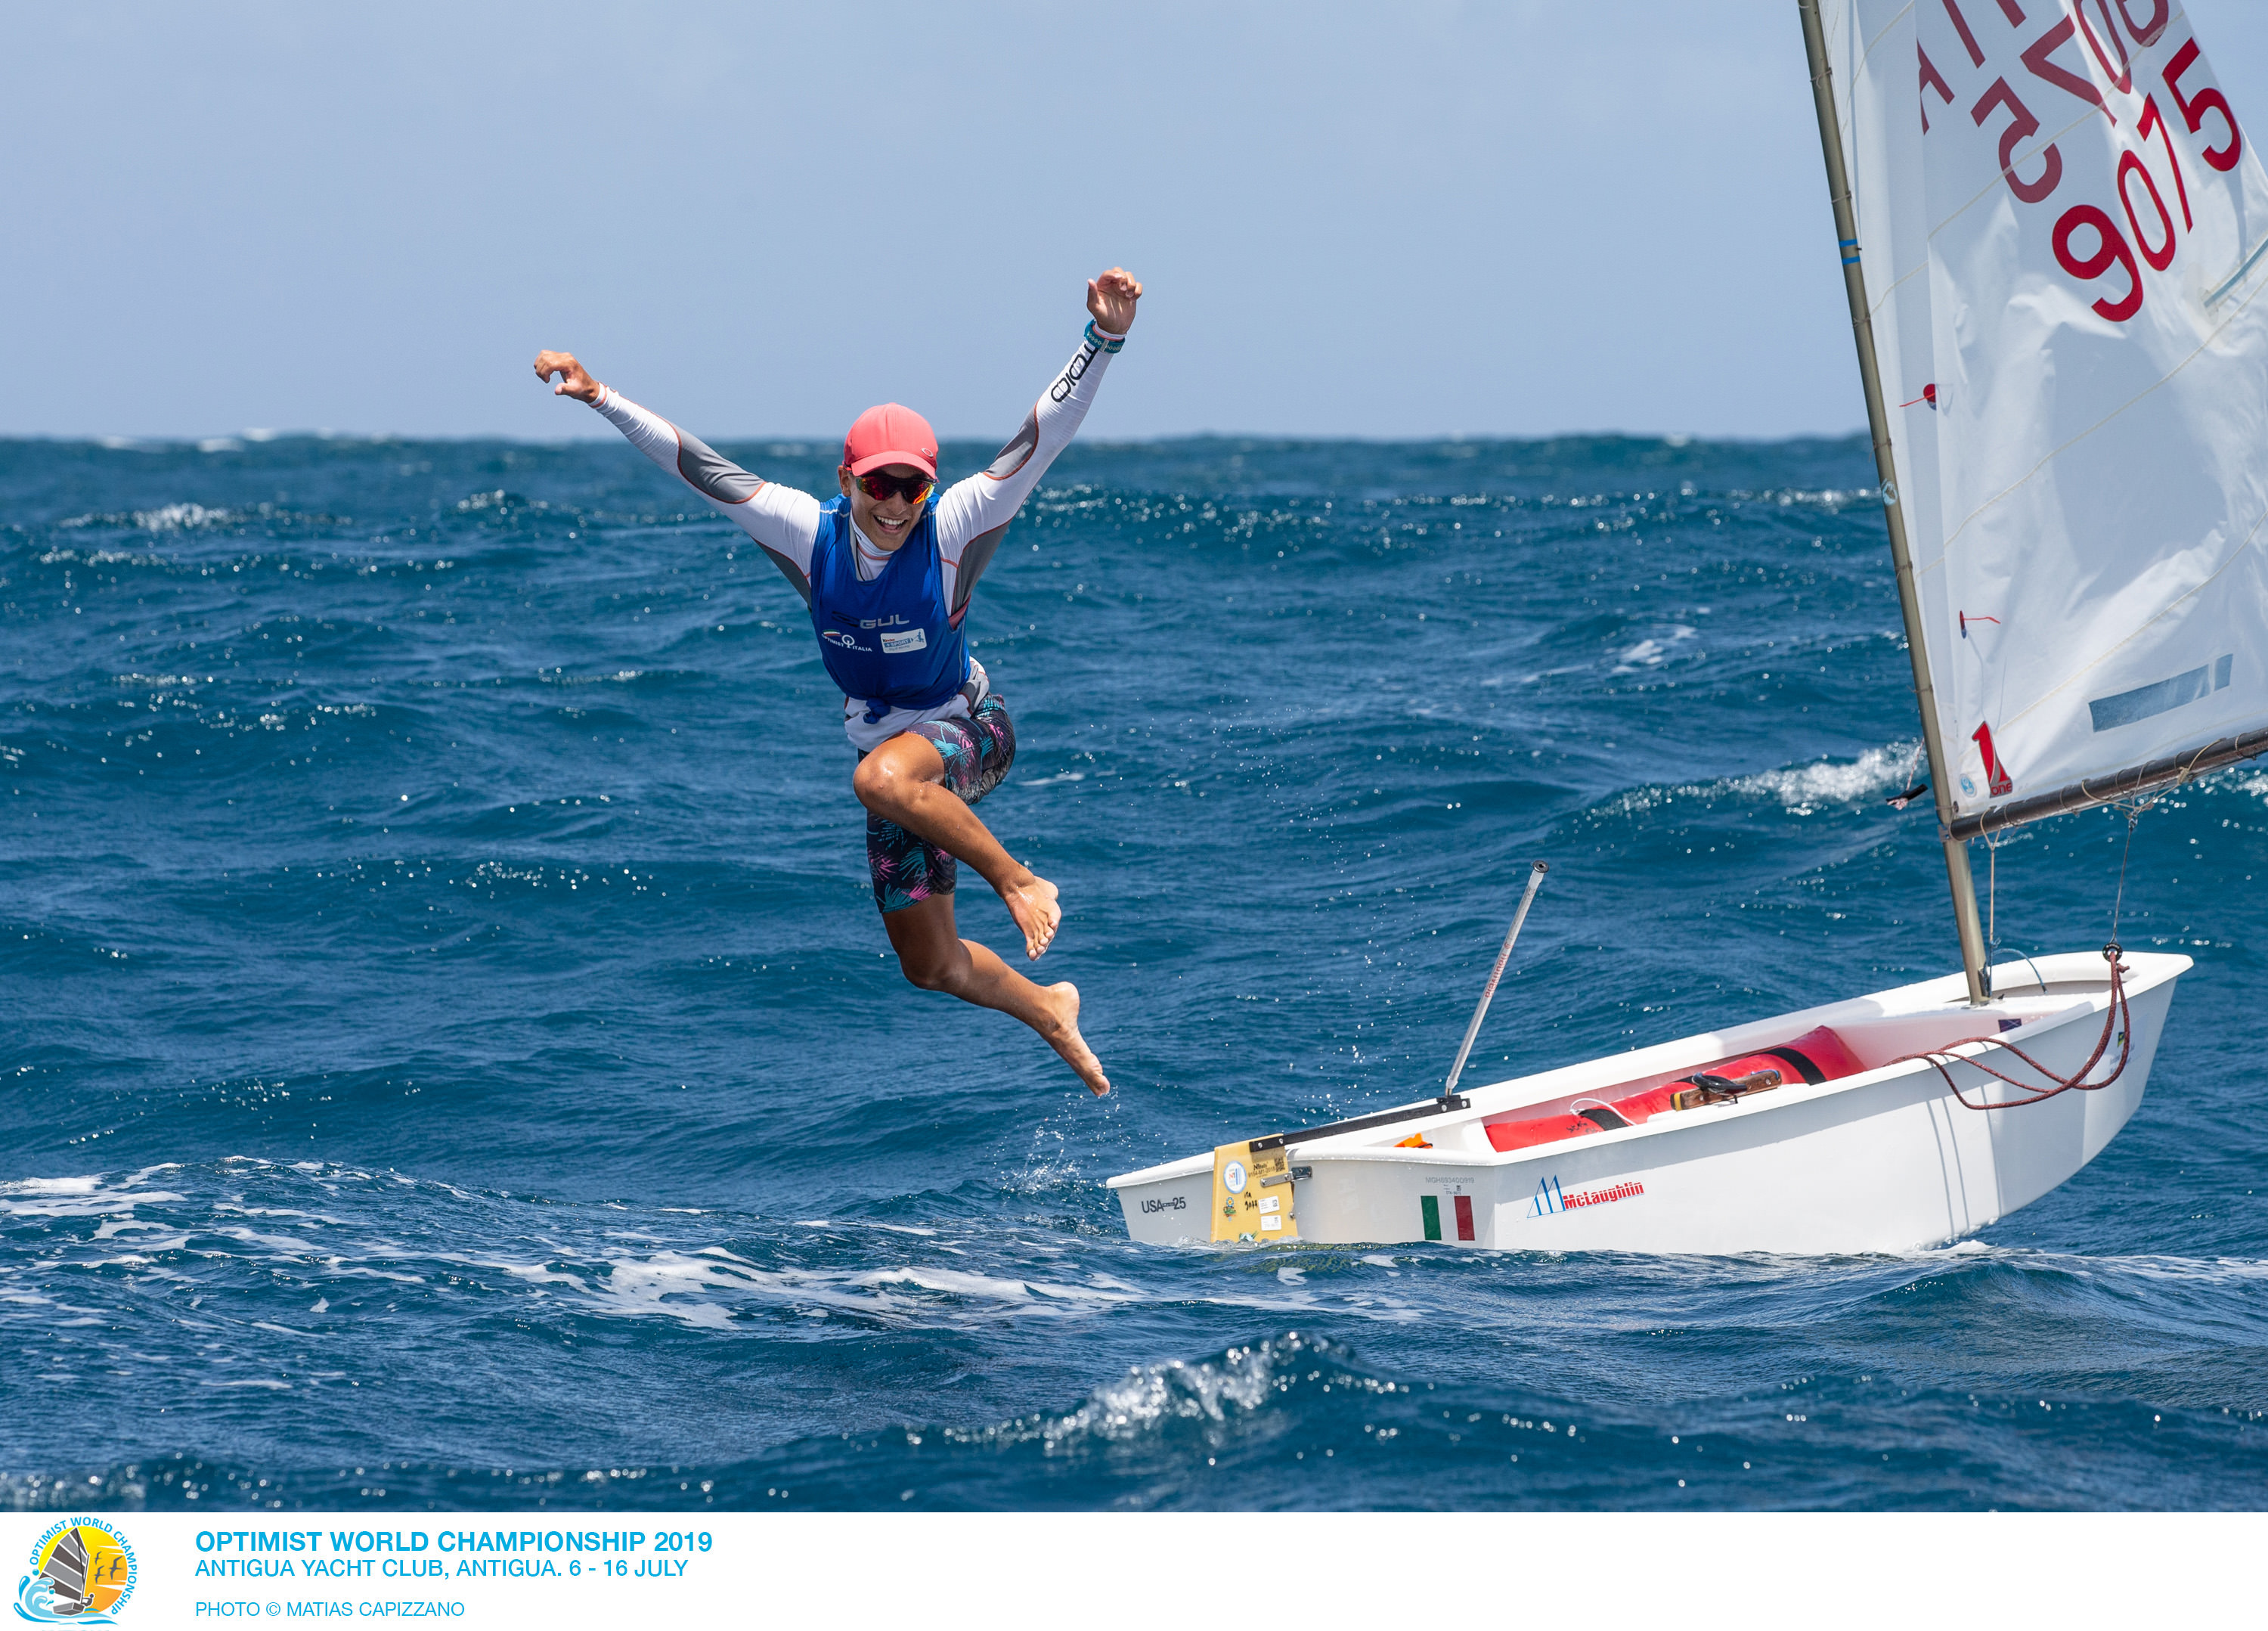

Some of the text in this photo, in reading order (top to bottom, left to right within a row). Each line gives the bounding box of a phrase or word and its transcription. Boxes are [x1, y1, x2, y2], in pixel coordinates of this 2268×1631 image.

[2052, 36, 2242, 322] 9075
[860, 614, 910, 629] GUL
[1142, 1196, 1186, 1214] USA 25
[1563, 1182, 1644, 1210] McLaughlin
